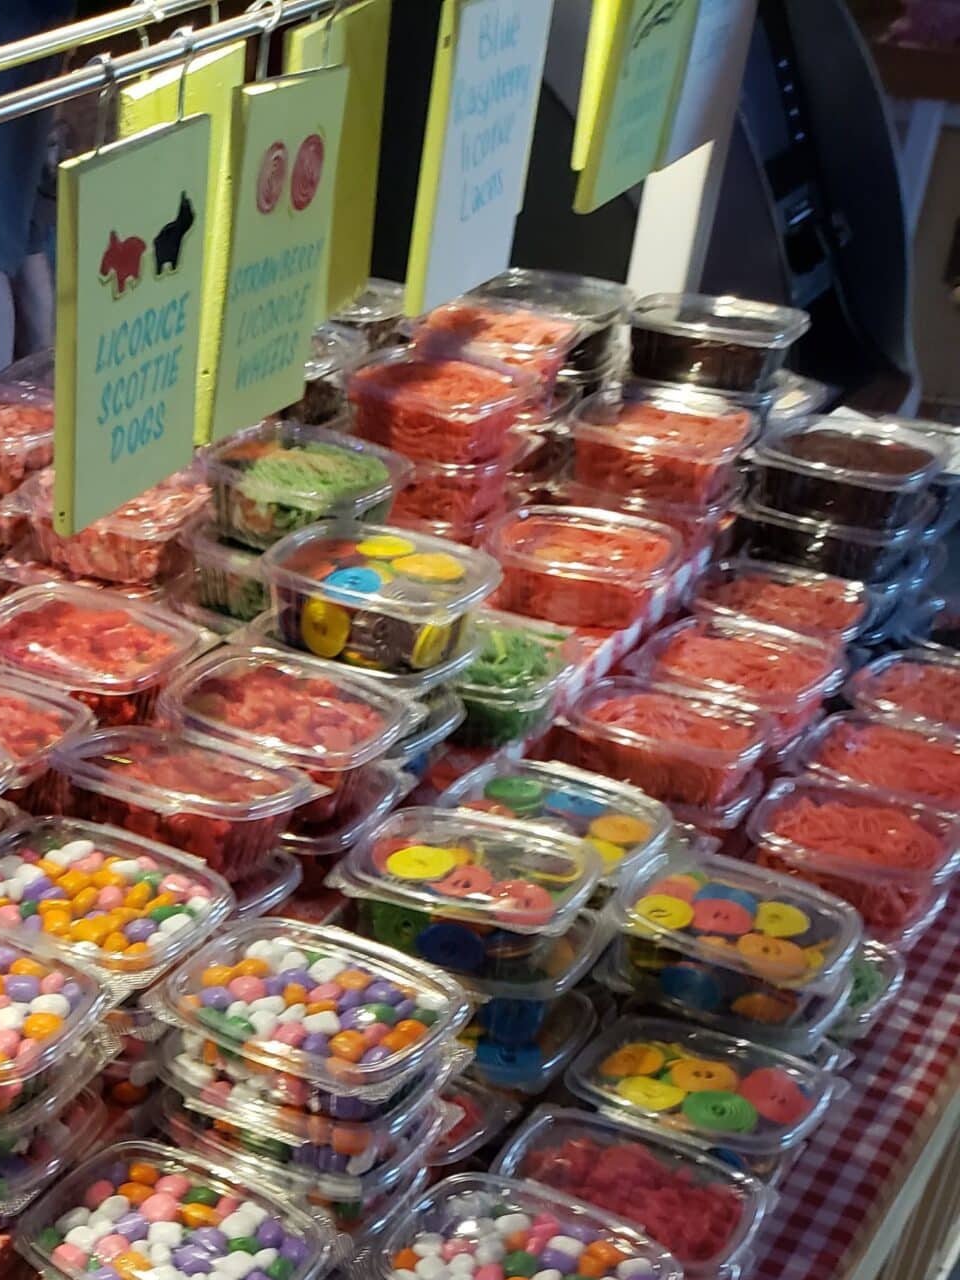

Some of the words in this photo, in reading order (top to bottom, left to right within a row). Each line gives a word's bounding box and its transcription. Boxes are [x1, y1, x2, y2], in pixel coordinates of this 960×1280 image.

[478, 8, 521, 62] Blue
[95, 291, 190, 375] LICORICE
[237, 283, 311, 348] LICORICE
[97, 344, 182, 425] SCOTTIE
[110, 401, 166, 464] DOGS
